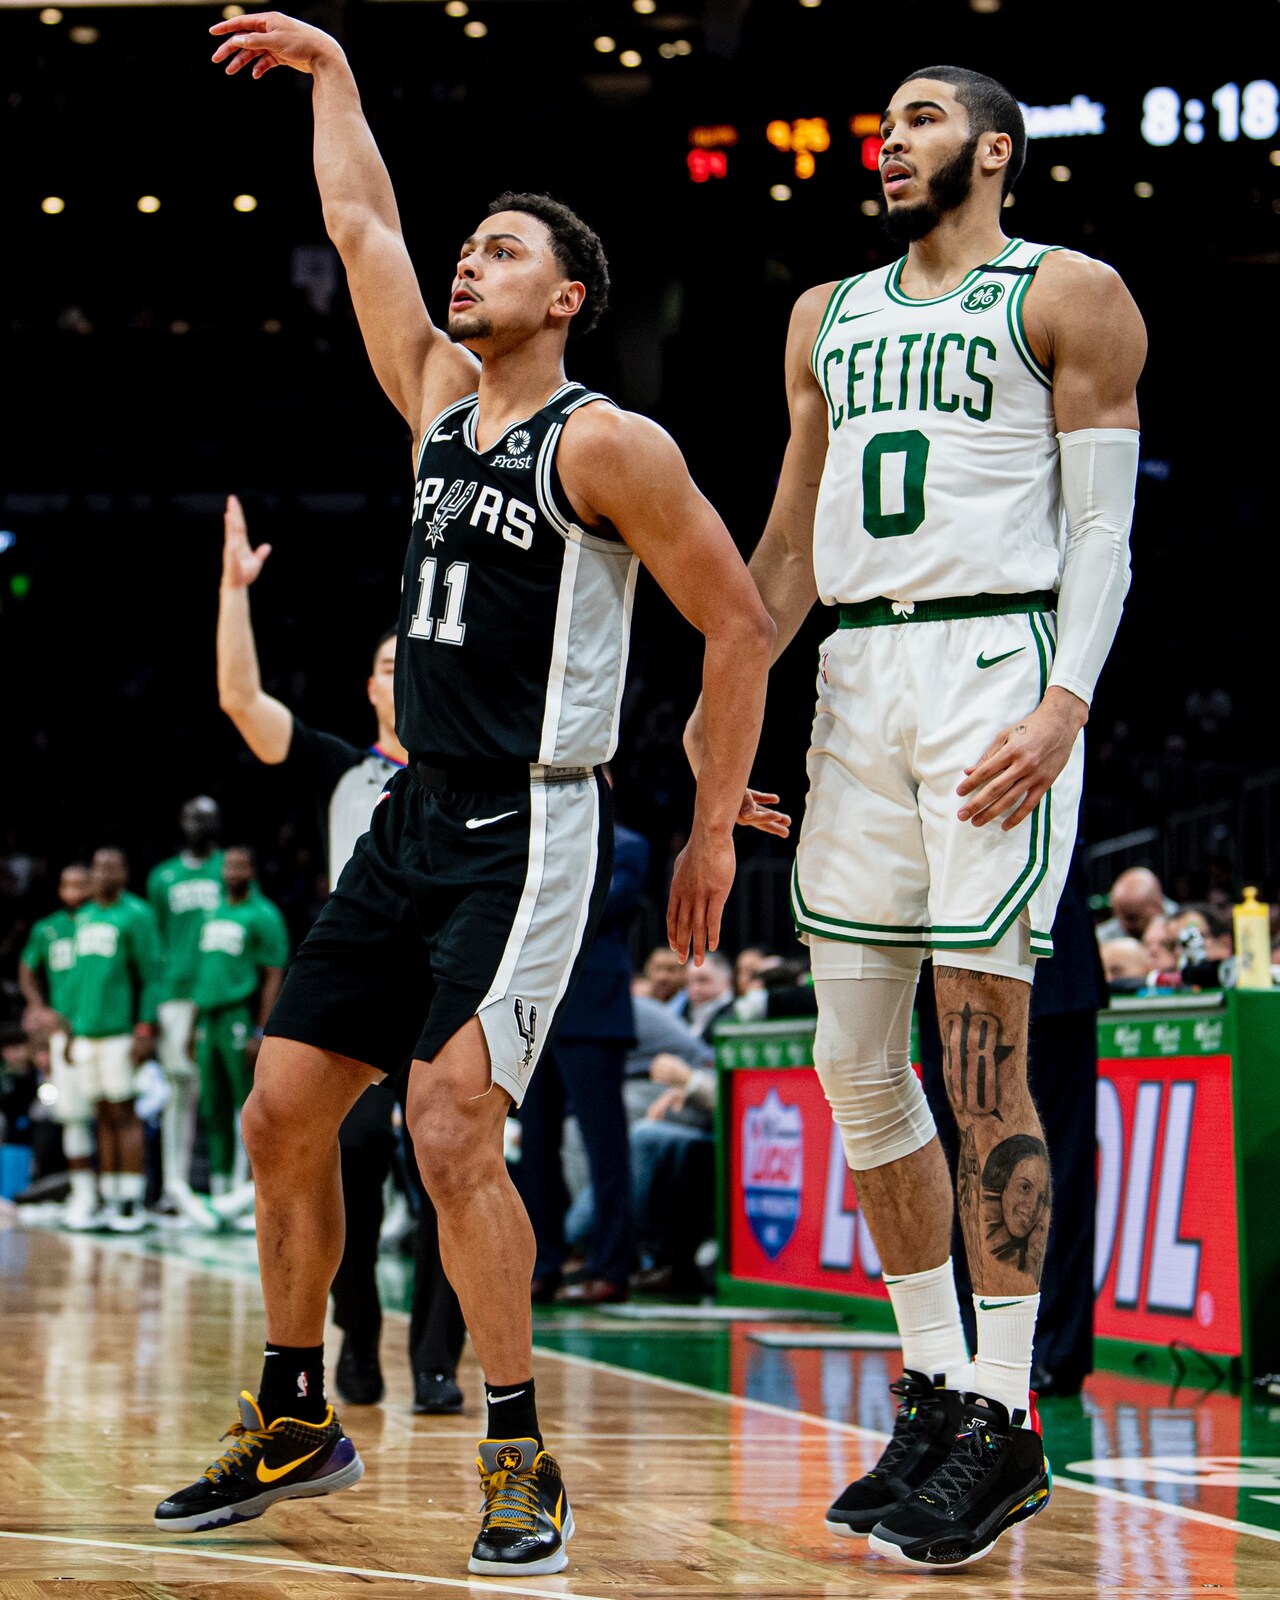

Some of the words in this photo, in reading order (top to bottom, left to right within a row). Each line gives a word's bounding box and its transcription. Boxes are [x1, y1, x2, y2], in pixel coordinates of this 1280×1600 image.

[1141, 79, 1280, 147] 8:18
[823, 332, 997, 431] CELTICS
[489, 454, 533, 470] Frost
[862, 429, 930, 539] 0
[407, 556, 469, 647] 11
